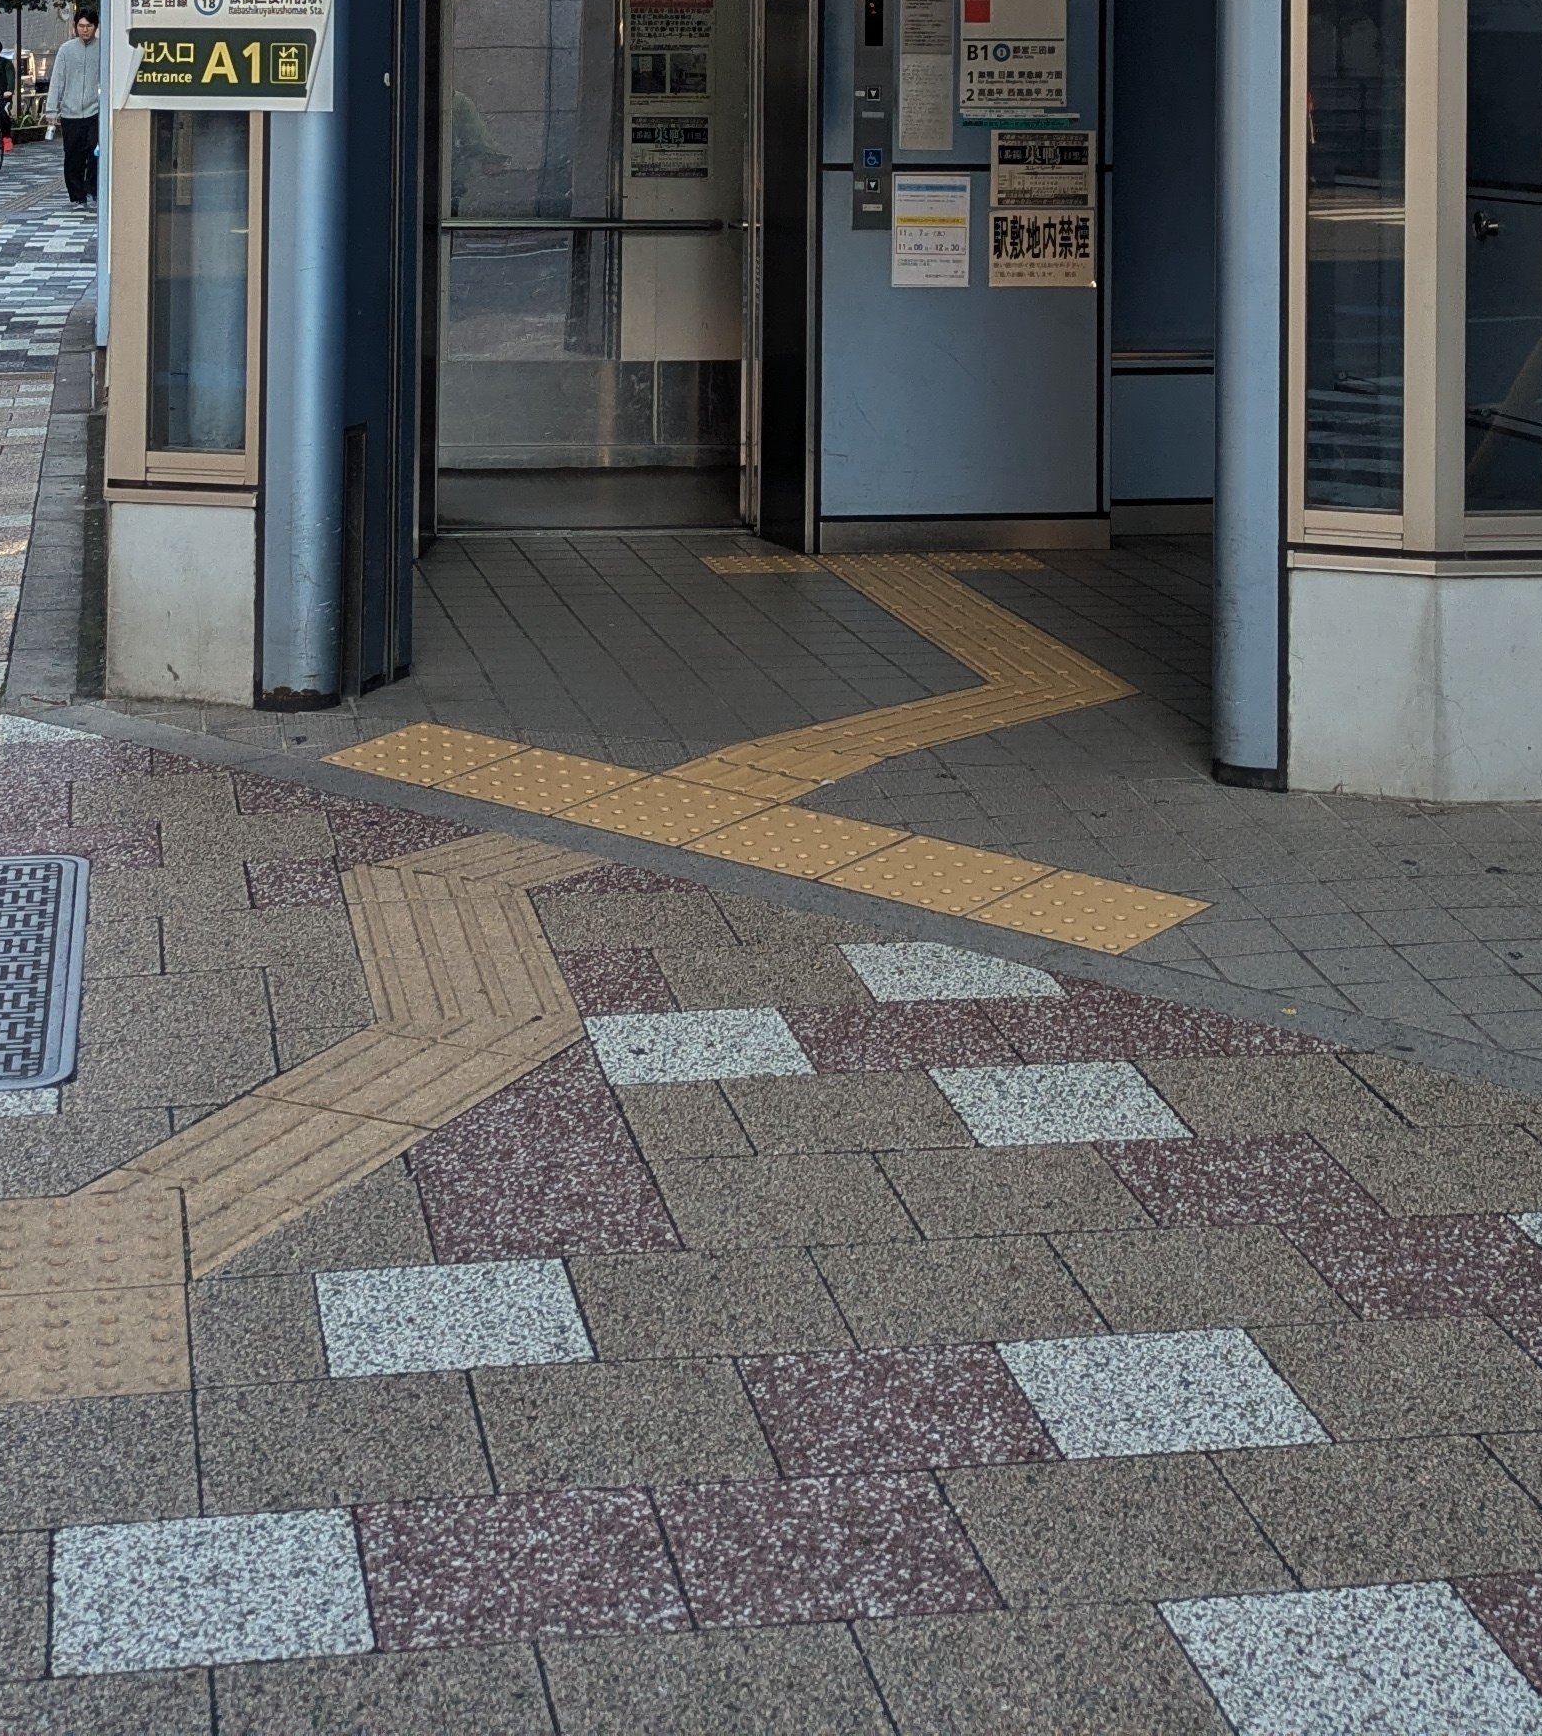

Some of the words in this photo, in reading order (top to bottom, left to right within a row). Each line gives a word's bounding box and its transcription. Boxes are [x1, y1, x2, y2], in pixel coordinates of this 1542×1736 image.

[309, 7, 324, 15] Sta.
[138, 41, 195, 64] 出入口
[967, 44, 989, 61] B1
[201, 41, 261, 84] A1
[136, 70, 193, 84] Entrance
[967, 71, 974, 84] 1
[966, 88, 975, 102] 2
[993, 215, 1090, 260] 駅敷地内禁煙
